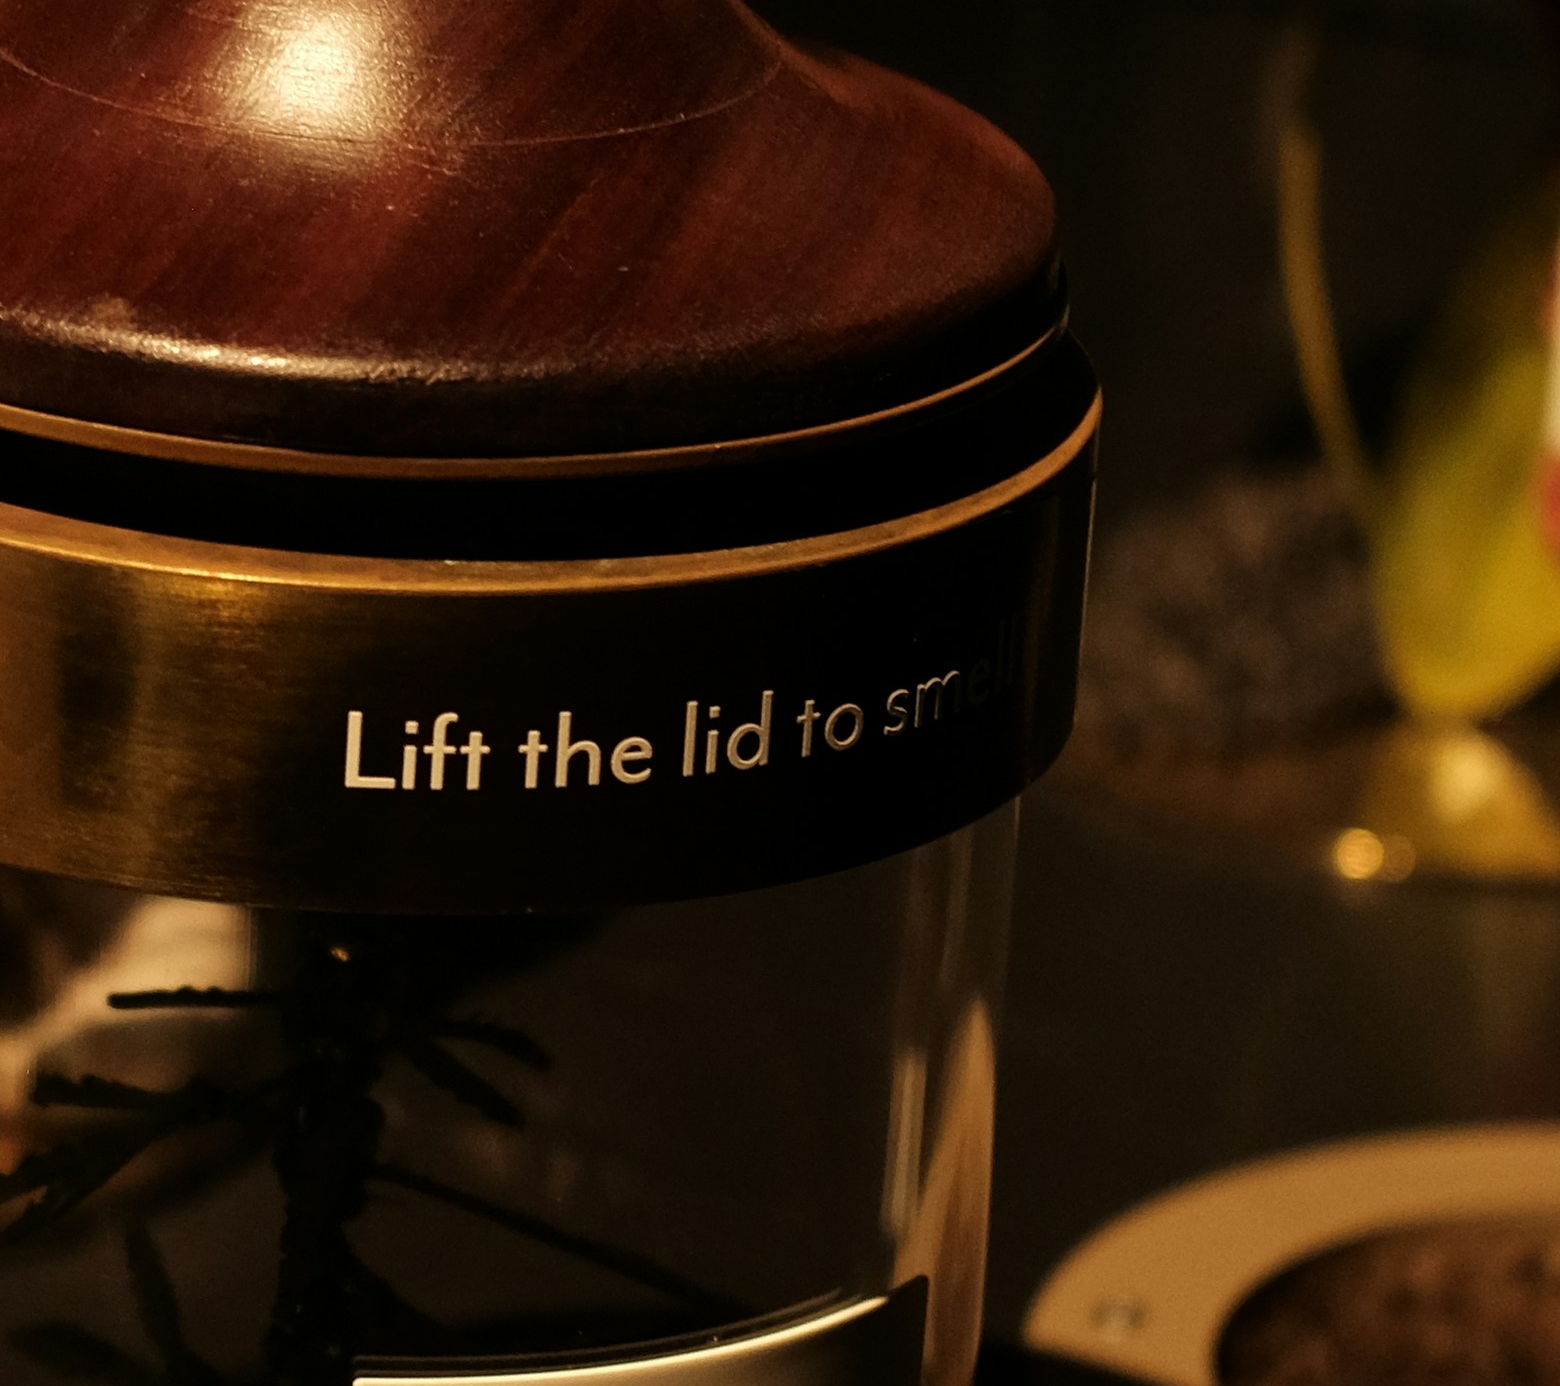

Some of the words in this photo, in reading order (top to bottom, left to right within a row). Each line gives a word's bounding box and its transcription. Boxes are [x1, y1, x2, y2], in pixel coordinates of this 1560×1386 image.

[343, 710, 491, 791] Lift
[518, 710, 654, 789] the
[682, 689, 774, 778] lid
[795, 698, 866, 759] to
